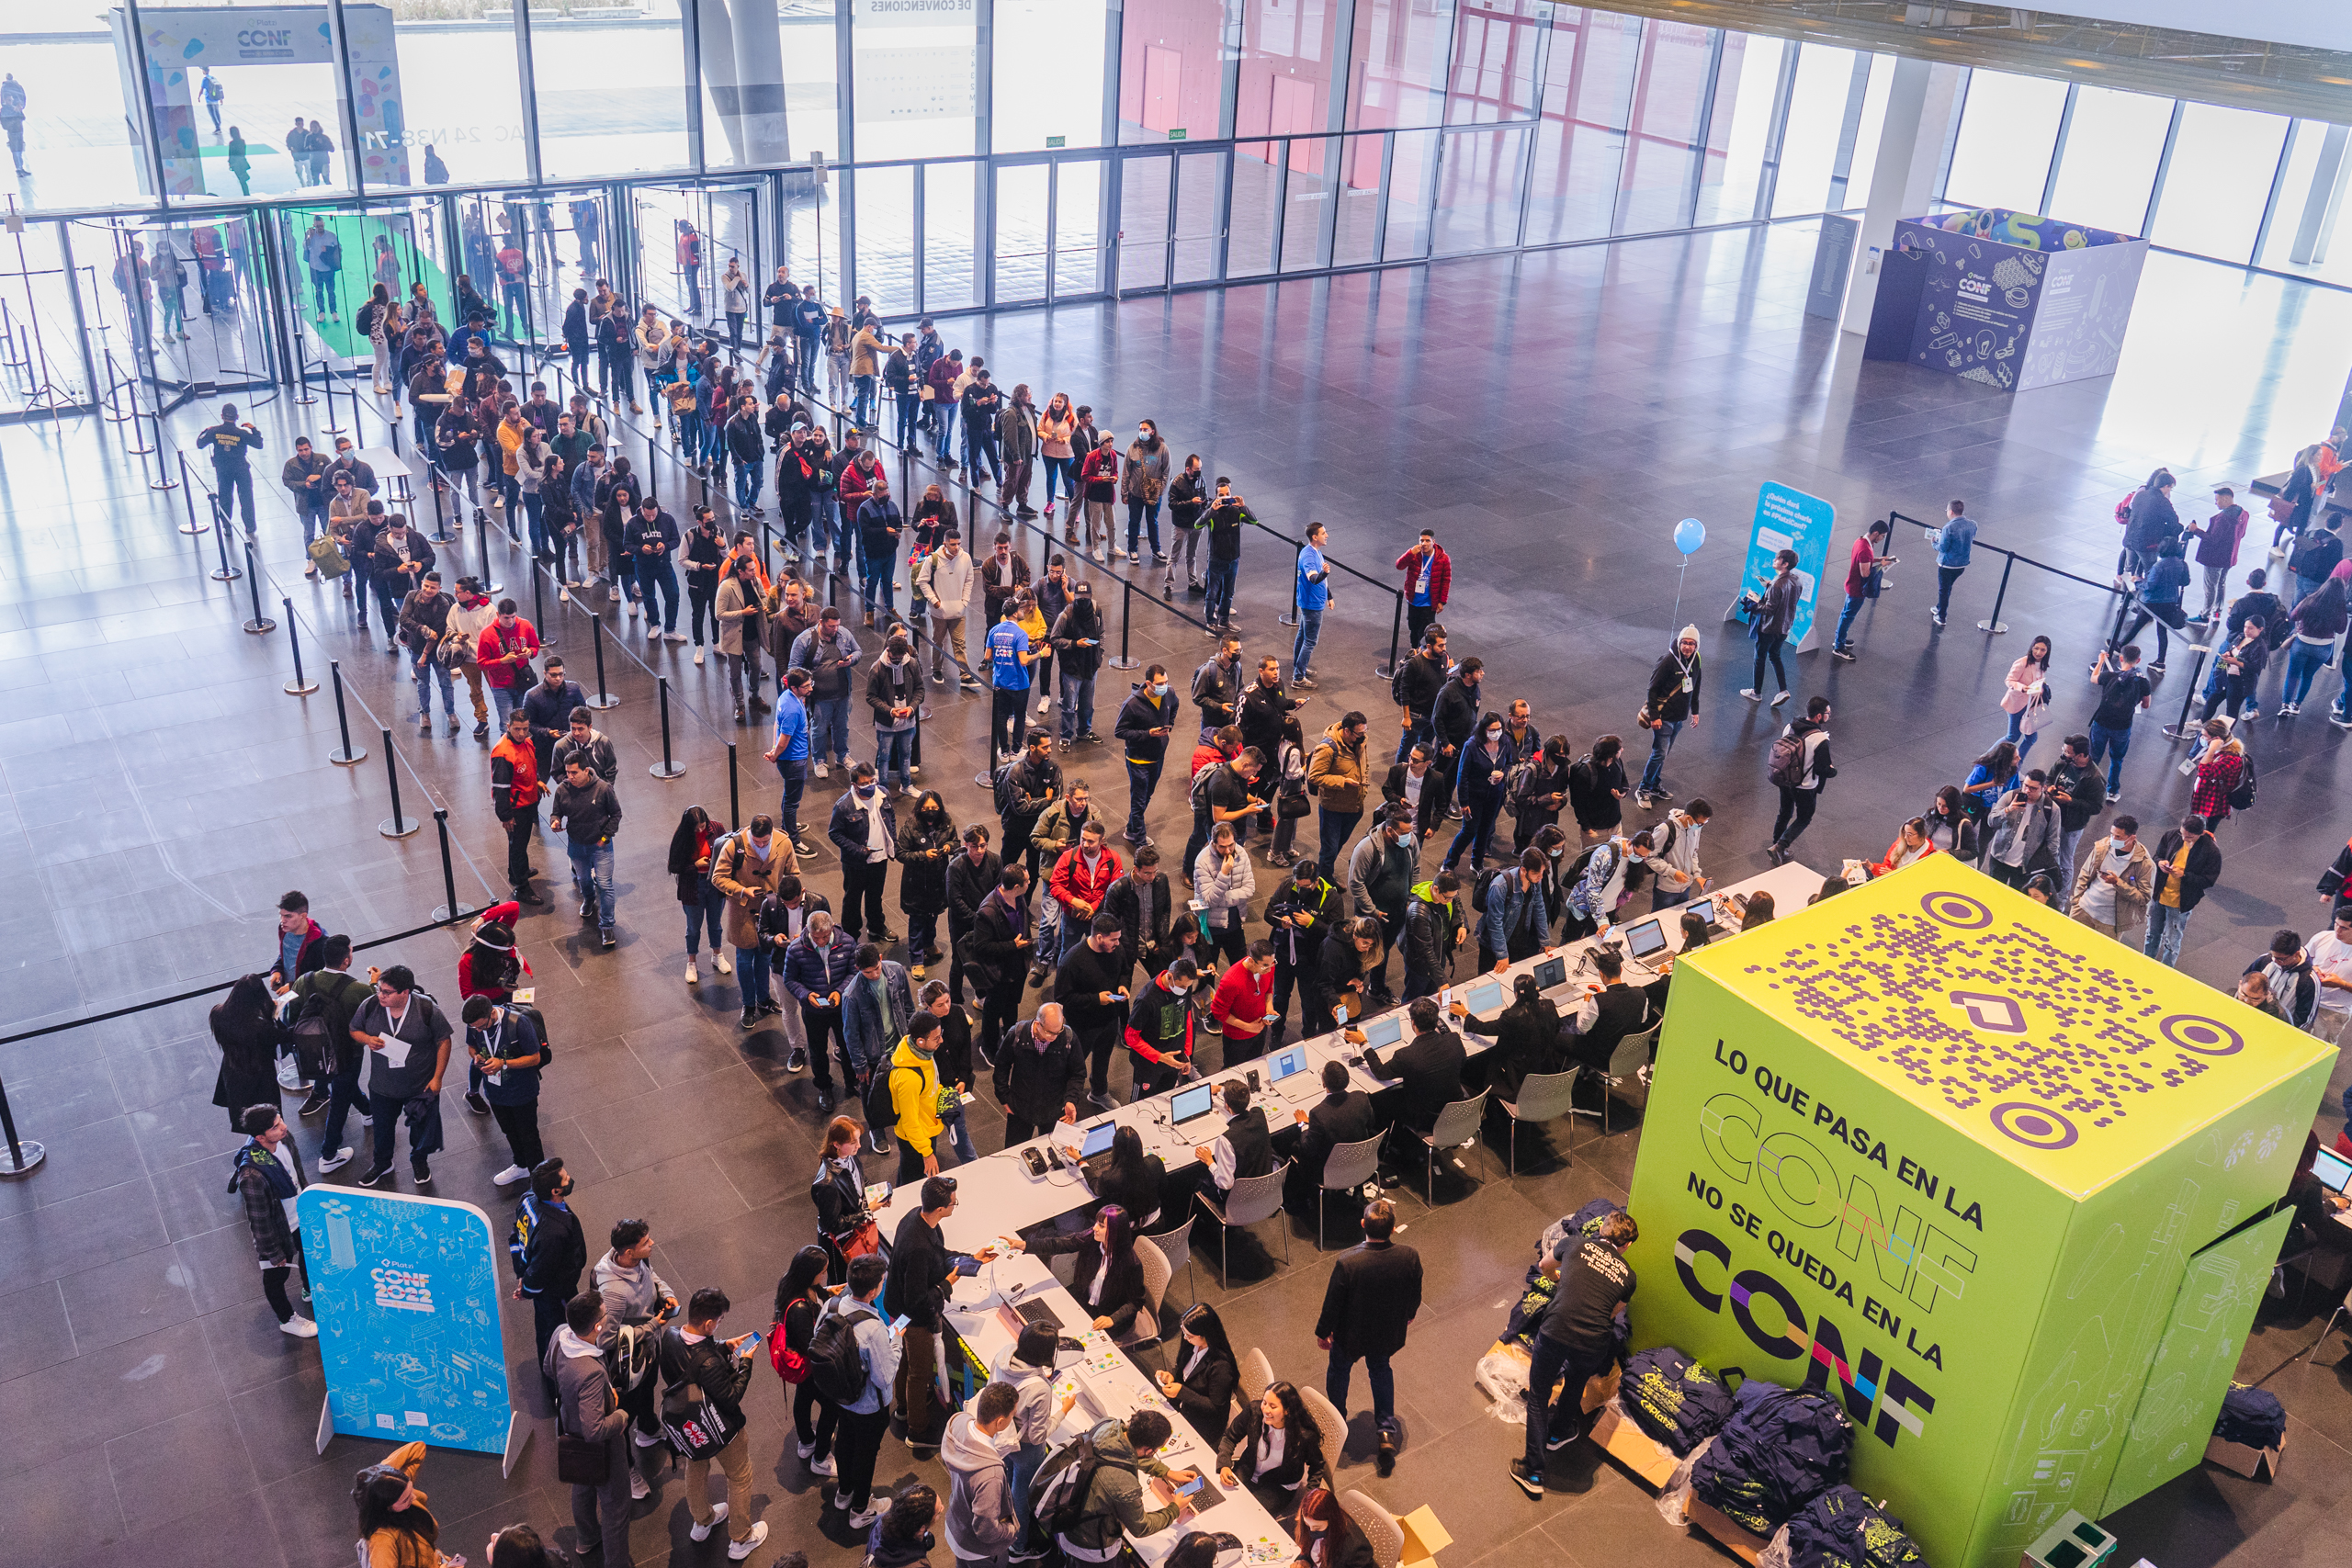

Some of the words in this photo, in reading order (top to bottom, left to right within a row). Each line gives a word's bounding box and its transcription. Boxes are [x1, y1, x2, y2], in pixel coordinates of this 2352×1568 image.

[237, 29, 292, 47] CONF
[1046, 138, 1065, 146] SALIDA
[1170, 130, 1186, 139] SALIDA
[1959, 277, 1992, 295] CONF
[2051, 274, 2075, 288] CONF
[1714, 1038, 1747, 1075] LO
[1754, 1066, 1810, 1117] QUE
[1813, 1102, 1889, 1170] PASA
[1896, 1156, 1939, 1200] EN
[1943, 1186, 1984, 1232] LA
[1700, 1093, 1978, 1314] CONF
[391, 1260, 414, 1269] Platzi
[1580, 1252, 1595, 1264] THE
[1595, 1261, 1624, 1287] ORIGINAL
[1584, 1243, 1629, 1277] QUIKSILVER
[1588, 1261, 1604, 1274] SINCE
[1591, 1253, 1611, 1266] SURF
[1611, 1265, 1620, 1274] CO
[370, 1267, 430, 1288] CONF
[1687, 1171, 1724, 1210] NO
[1729, 1203, 1762, 1240] SE
[1767, 1229, 1854, 1309] QUEDA
[1862, 1295, 1902, 1338] EN
[1906, 1326, 1943, 1372] LA
[374, 1282, 433, 1303] 2022
[1674, 1228, 1936, 1449] CONF
[1649, 1406, 1673, 1429] Platzi
